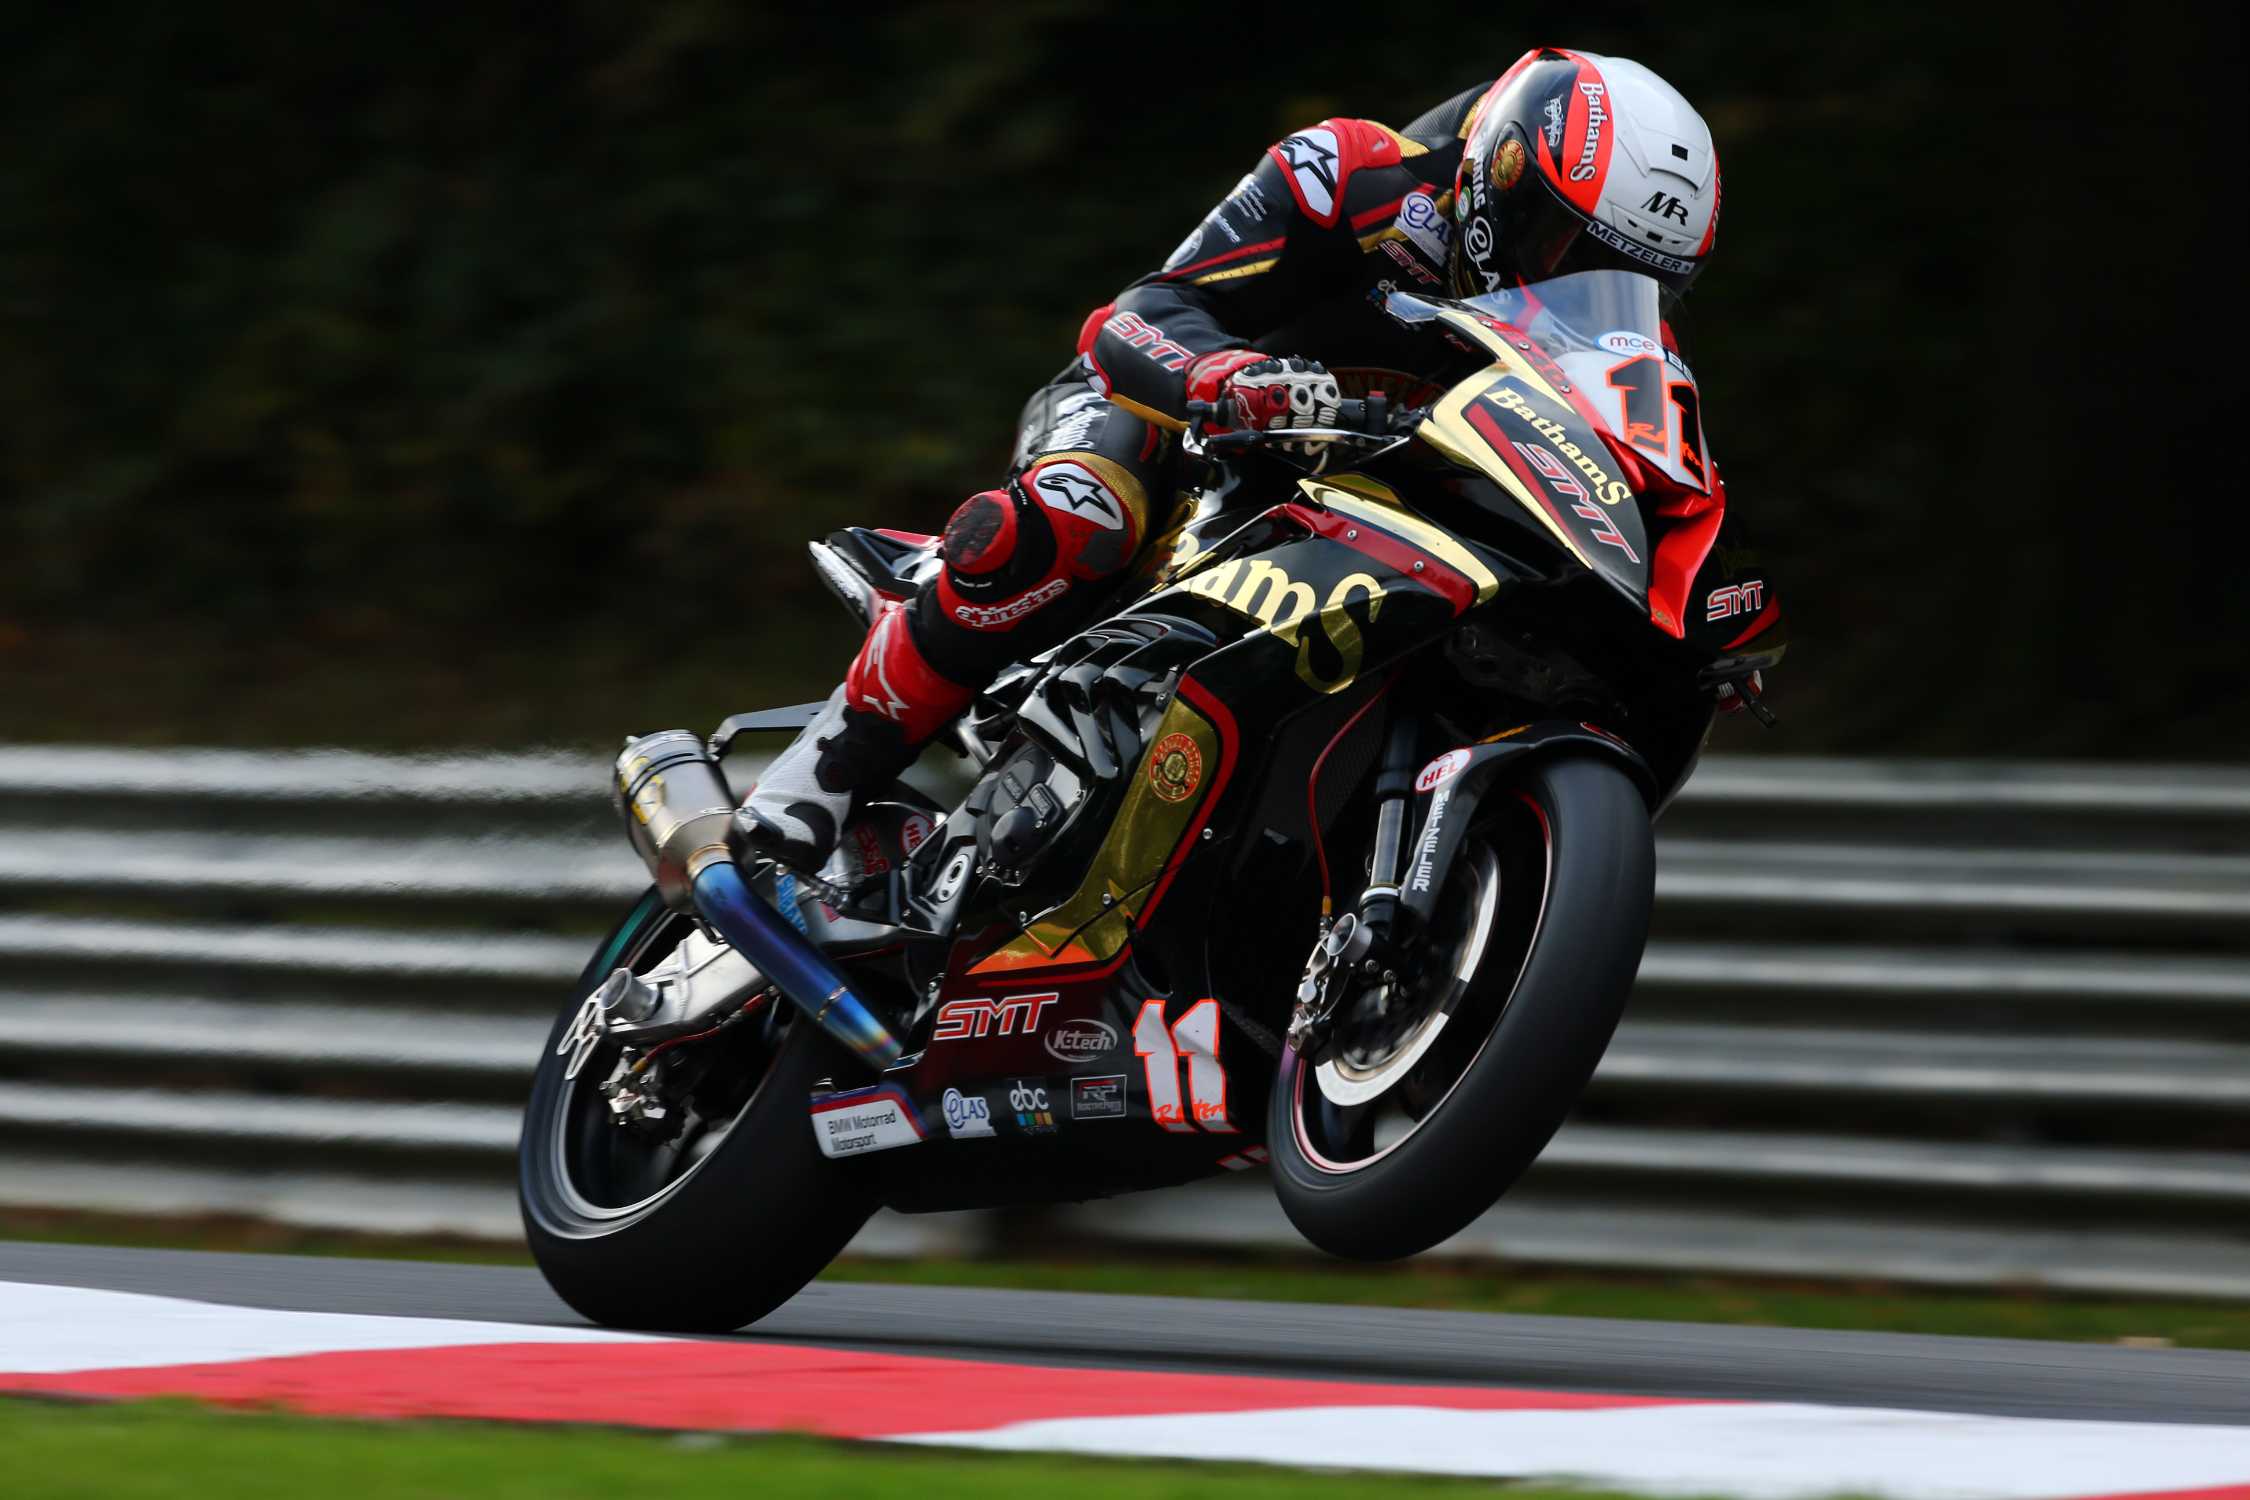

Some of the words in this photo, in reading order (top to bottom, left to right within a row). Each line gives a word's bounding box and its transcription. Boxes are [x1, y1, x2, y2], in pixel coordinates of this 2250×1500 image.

[1641, 191, 1689, 226] MR
[1589, 222, 1683, 272] METZELER
[1103, 312, 1196, 372] SMT
[1610, 336, 1656, 351] mce
[1511, 441, 1641, 563] SMT
[1706, 580, 1763, 622] SMT
[1422, 762, 1459, 787] HEL
[1411, 790, 1450, 892] METZELER
[933, 992, 1060, 1041] SMT
[1131, 998, 1248, 1134] 11
[1009, 1080, 1050, 1112] ebc
[828, 1118, 852, 1135] BMW
[853, 1109, 896, 1131] Motorrad
[831, 1133, 877, 1152] Motorsport
